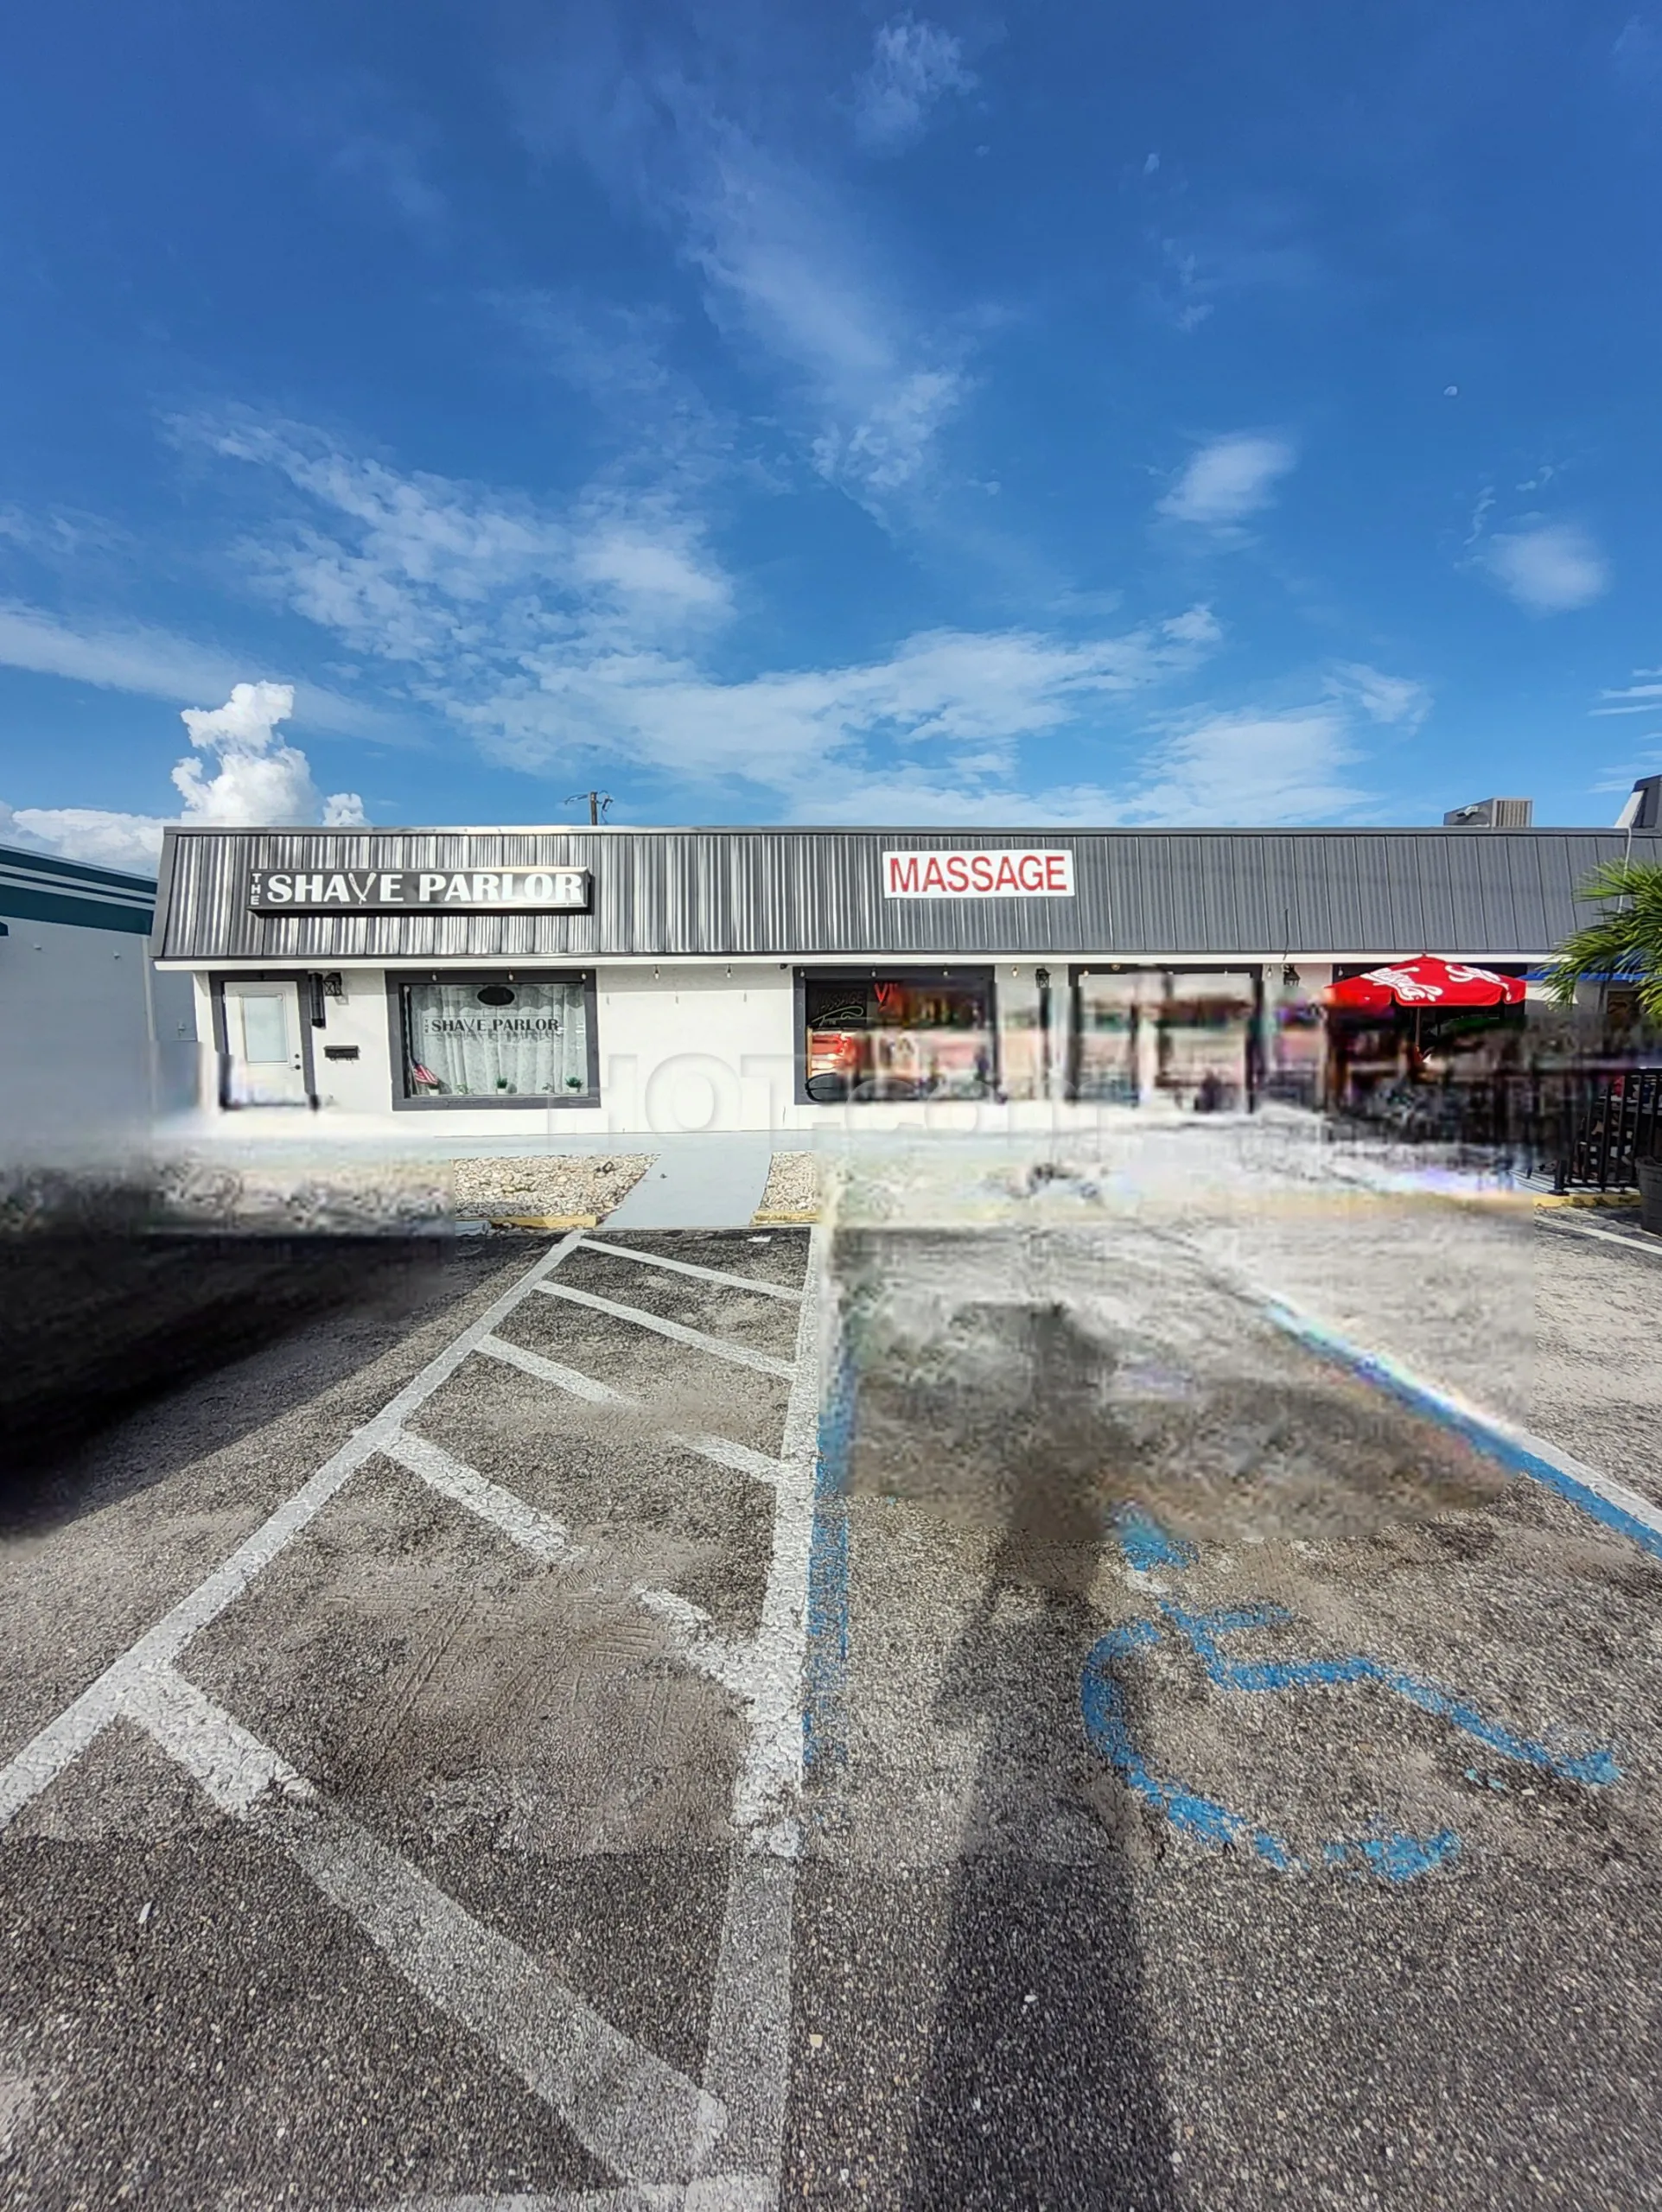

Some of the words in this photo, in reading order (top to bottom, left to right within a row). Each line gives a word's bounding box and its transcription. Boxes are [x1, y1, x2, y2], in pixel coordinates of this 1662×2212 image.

[251, 873, 260, 906] THE
[267, 872, 404, 905] SHAVE
[419, 873, 583, 903] PARLOR
[889, 855, 1067, 893] MASSAGE
[431, 1018, 487, 1033] SHAVE
[493, 1018, 559, 1032] PARLOR
